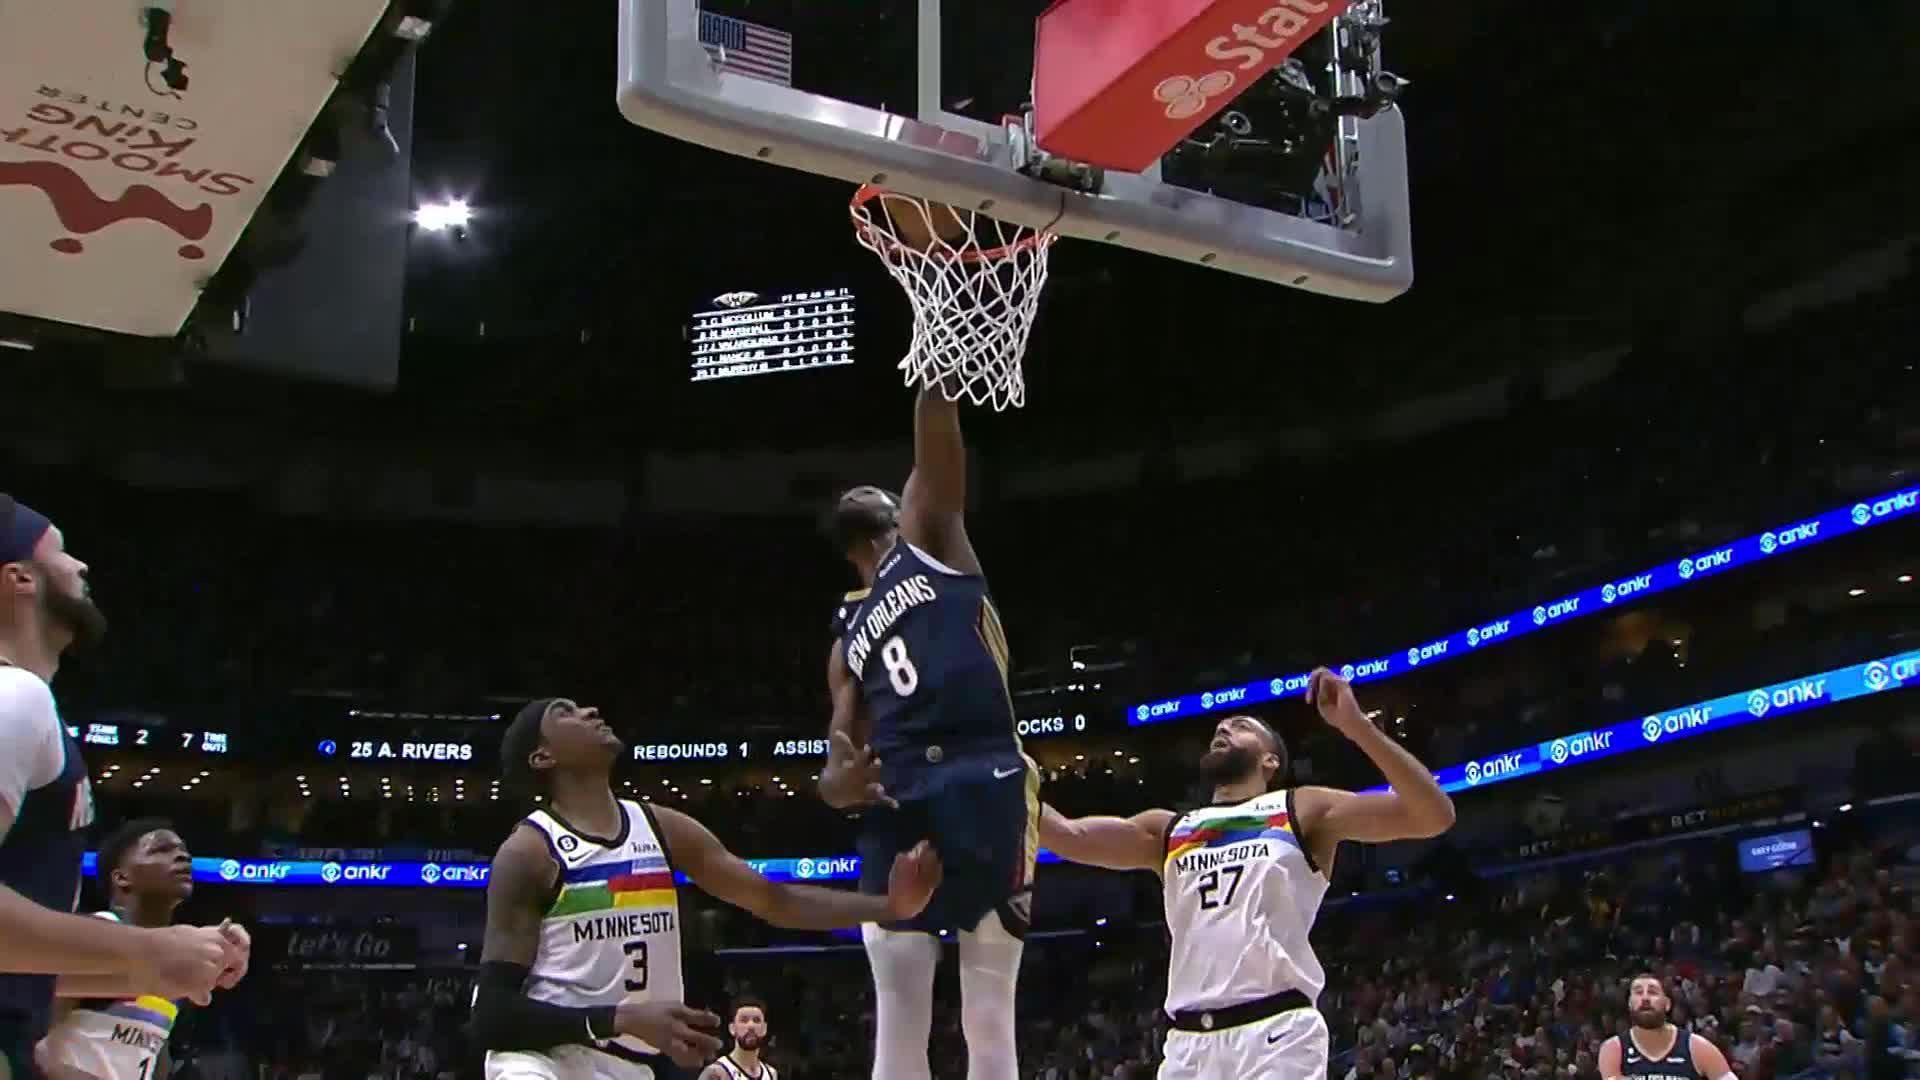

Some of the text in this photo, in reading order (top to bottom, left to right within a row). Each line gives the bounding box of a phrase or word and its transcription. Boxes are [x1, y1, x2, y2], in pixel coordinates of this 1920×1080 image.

[866, 574, 937, 639] ORLEANS
[1151, 490, 1919, 717] ankr ankr ank ankr ankr ankr ankr ankr ankr ankr ankr
[881, 636, 918, 697] 8
[136, 729, 148, 744] 2
[634, 714, 1085, 759] REBOUNDS 1 ASSIST OCKS 0
[1483, 658, 1920, 777] ankr ankr ankr ankr an
[181, 733, 193, 748] 7
[378, 742, 397, 757] A.
[402, 743, 472, 760] RIVERS
[243, 858, 857, 881] ankr ankr ankr ankr
[1175, 843, 1269, 875] MINNESOTA
[1198, 865, 1245, 910] 27
[623, 941, 648, 991] 3
[139, 1056, 152, 1080] 1
